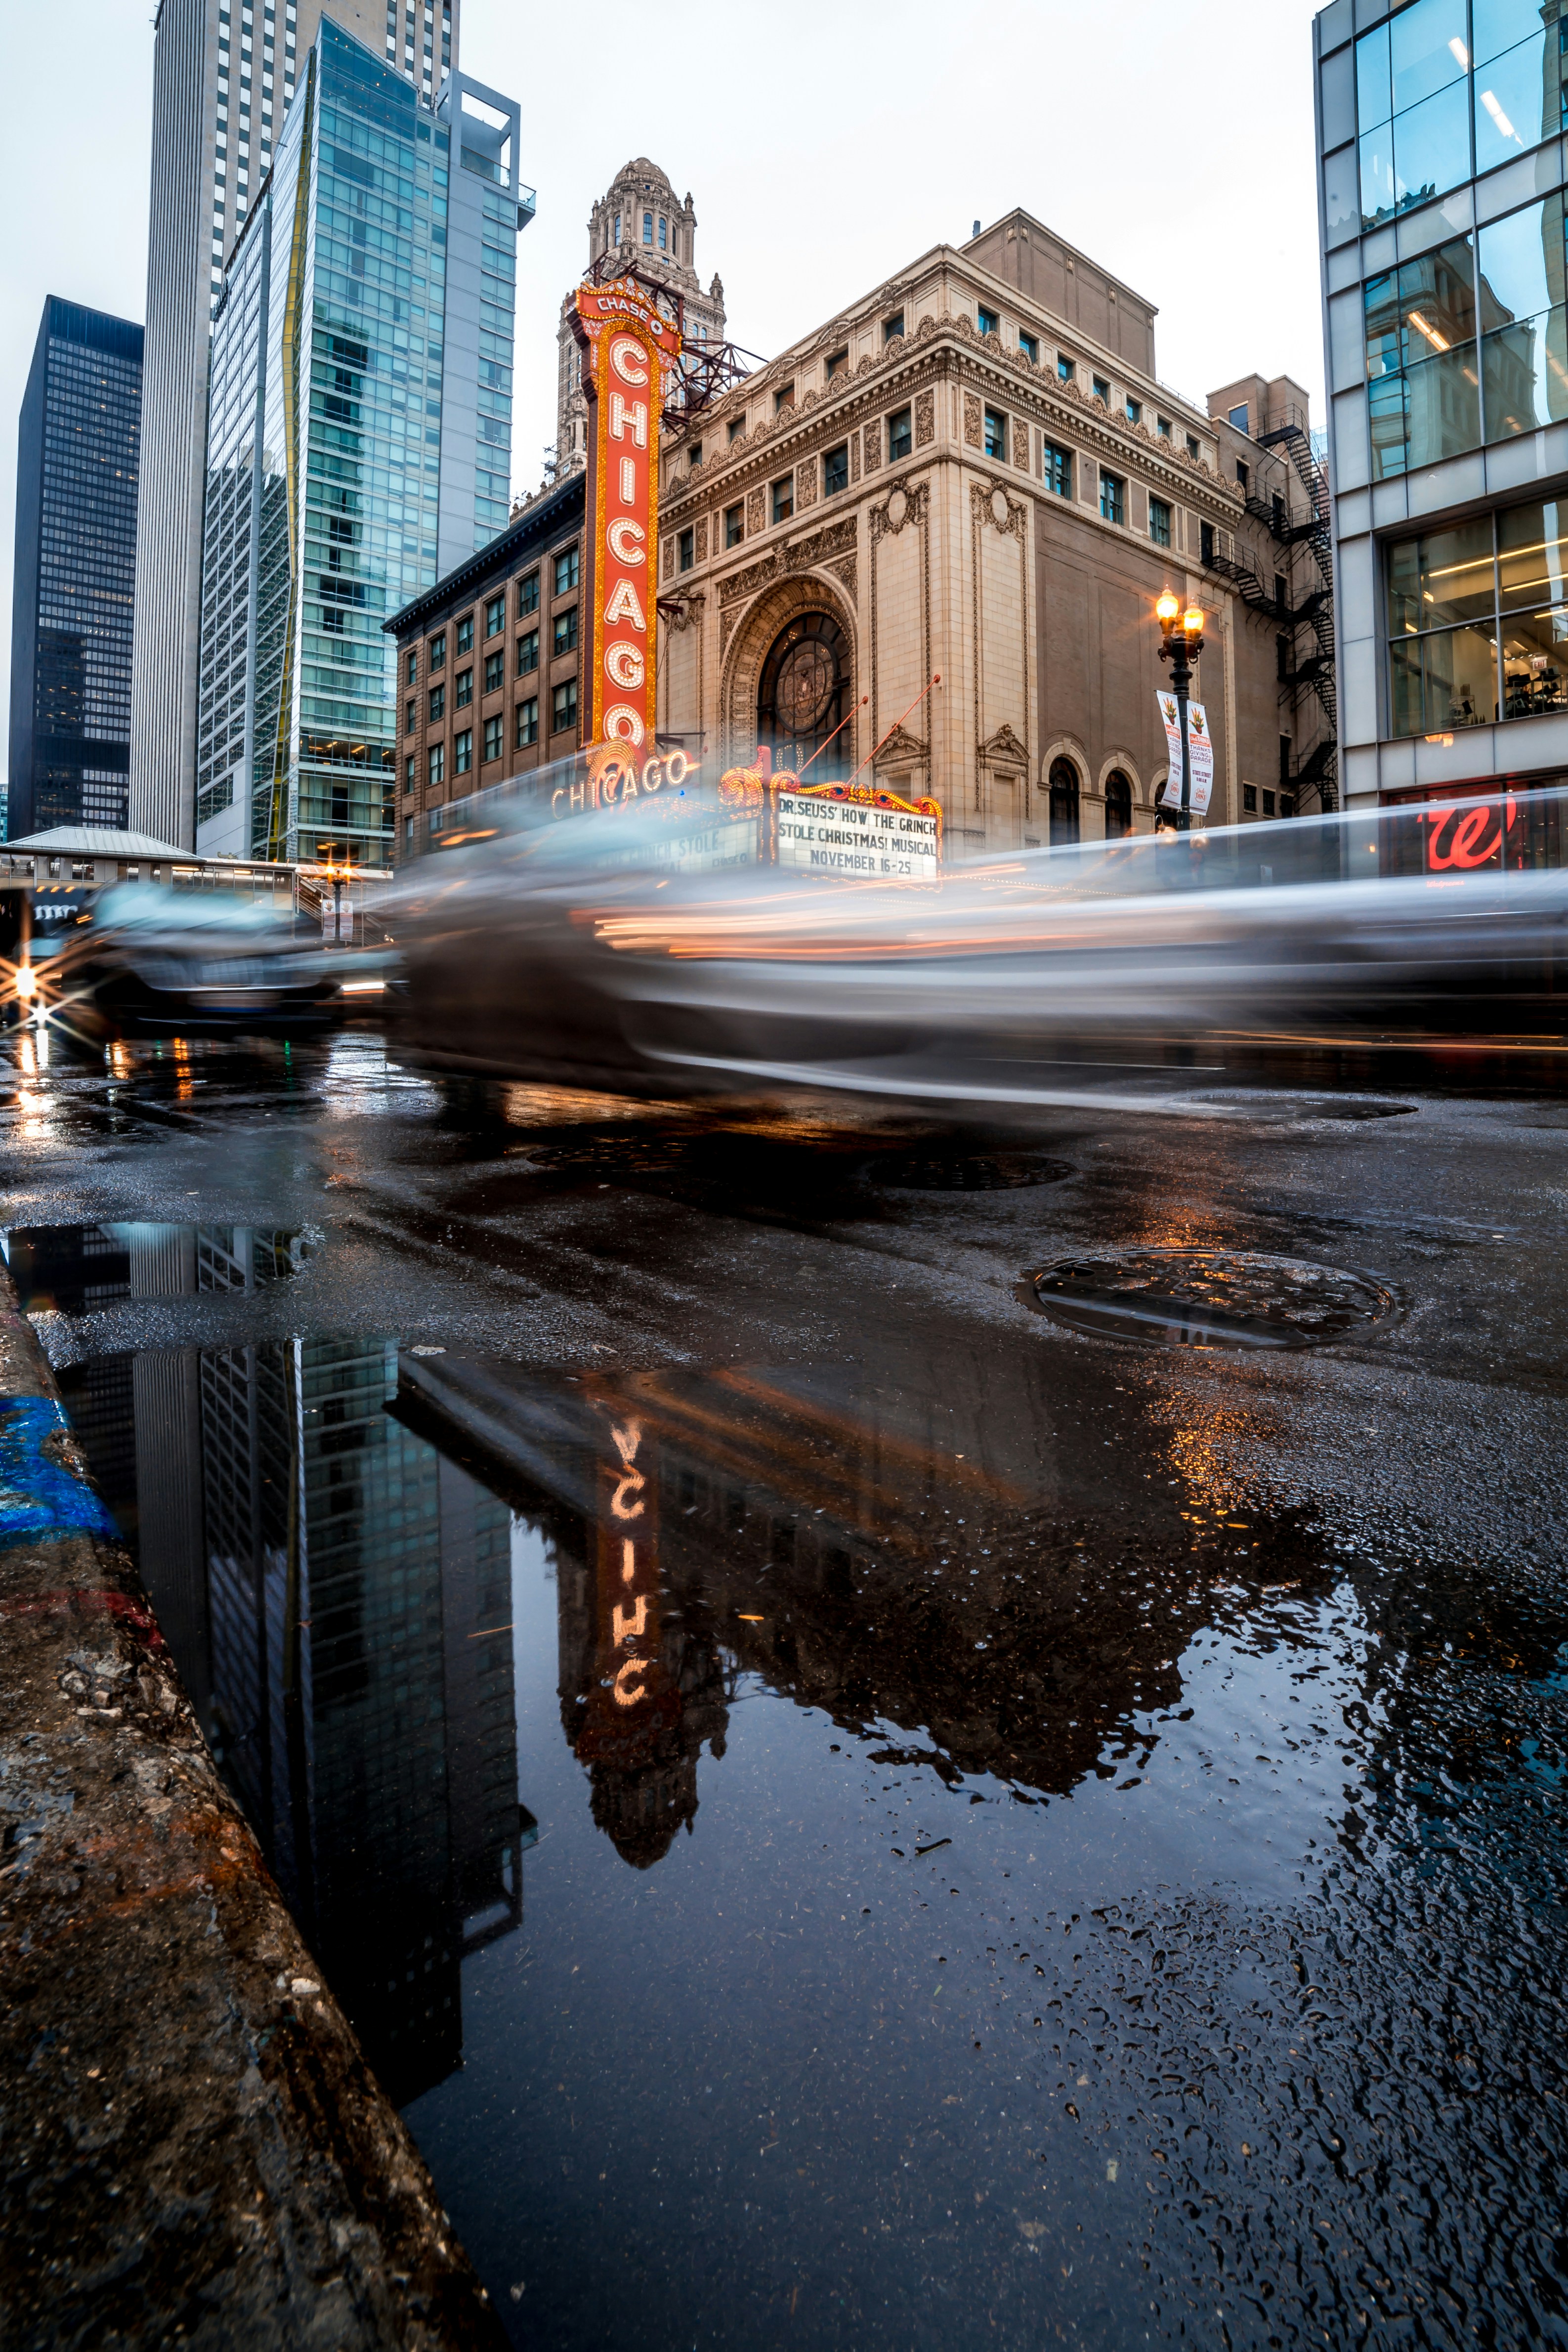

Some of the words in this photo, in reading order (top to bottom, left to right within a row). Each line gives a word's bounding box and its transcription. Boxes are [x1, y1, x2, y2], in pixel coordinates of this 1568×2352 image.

[597, 298, 649, 323] CHASE
[604, 339, 648, 748] CHICAGO
[1534, 660, 1544, 669] EXIT
[1189, 745, 1211, 753] THANKS
[1190, 755, 1212, 764] PARADE
[551, 748, 688, 819] CHICAGO
[842, 808, 867, 825] HOW
[874, 813, 894, 829] THE
[899, 817, 936, 835] GRINCH
[678, 831, 719, 857] STOLE
[779, 822, 814, 841] STOLE
[818, 827, 887, 850] CHRISTMAS!
[891, 838, 936, 856] MUSICAL
[713, 856, 738, 866] CHASE
[811, 850, 875, 870] NOVEMBER
